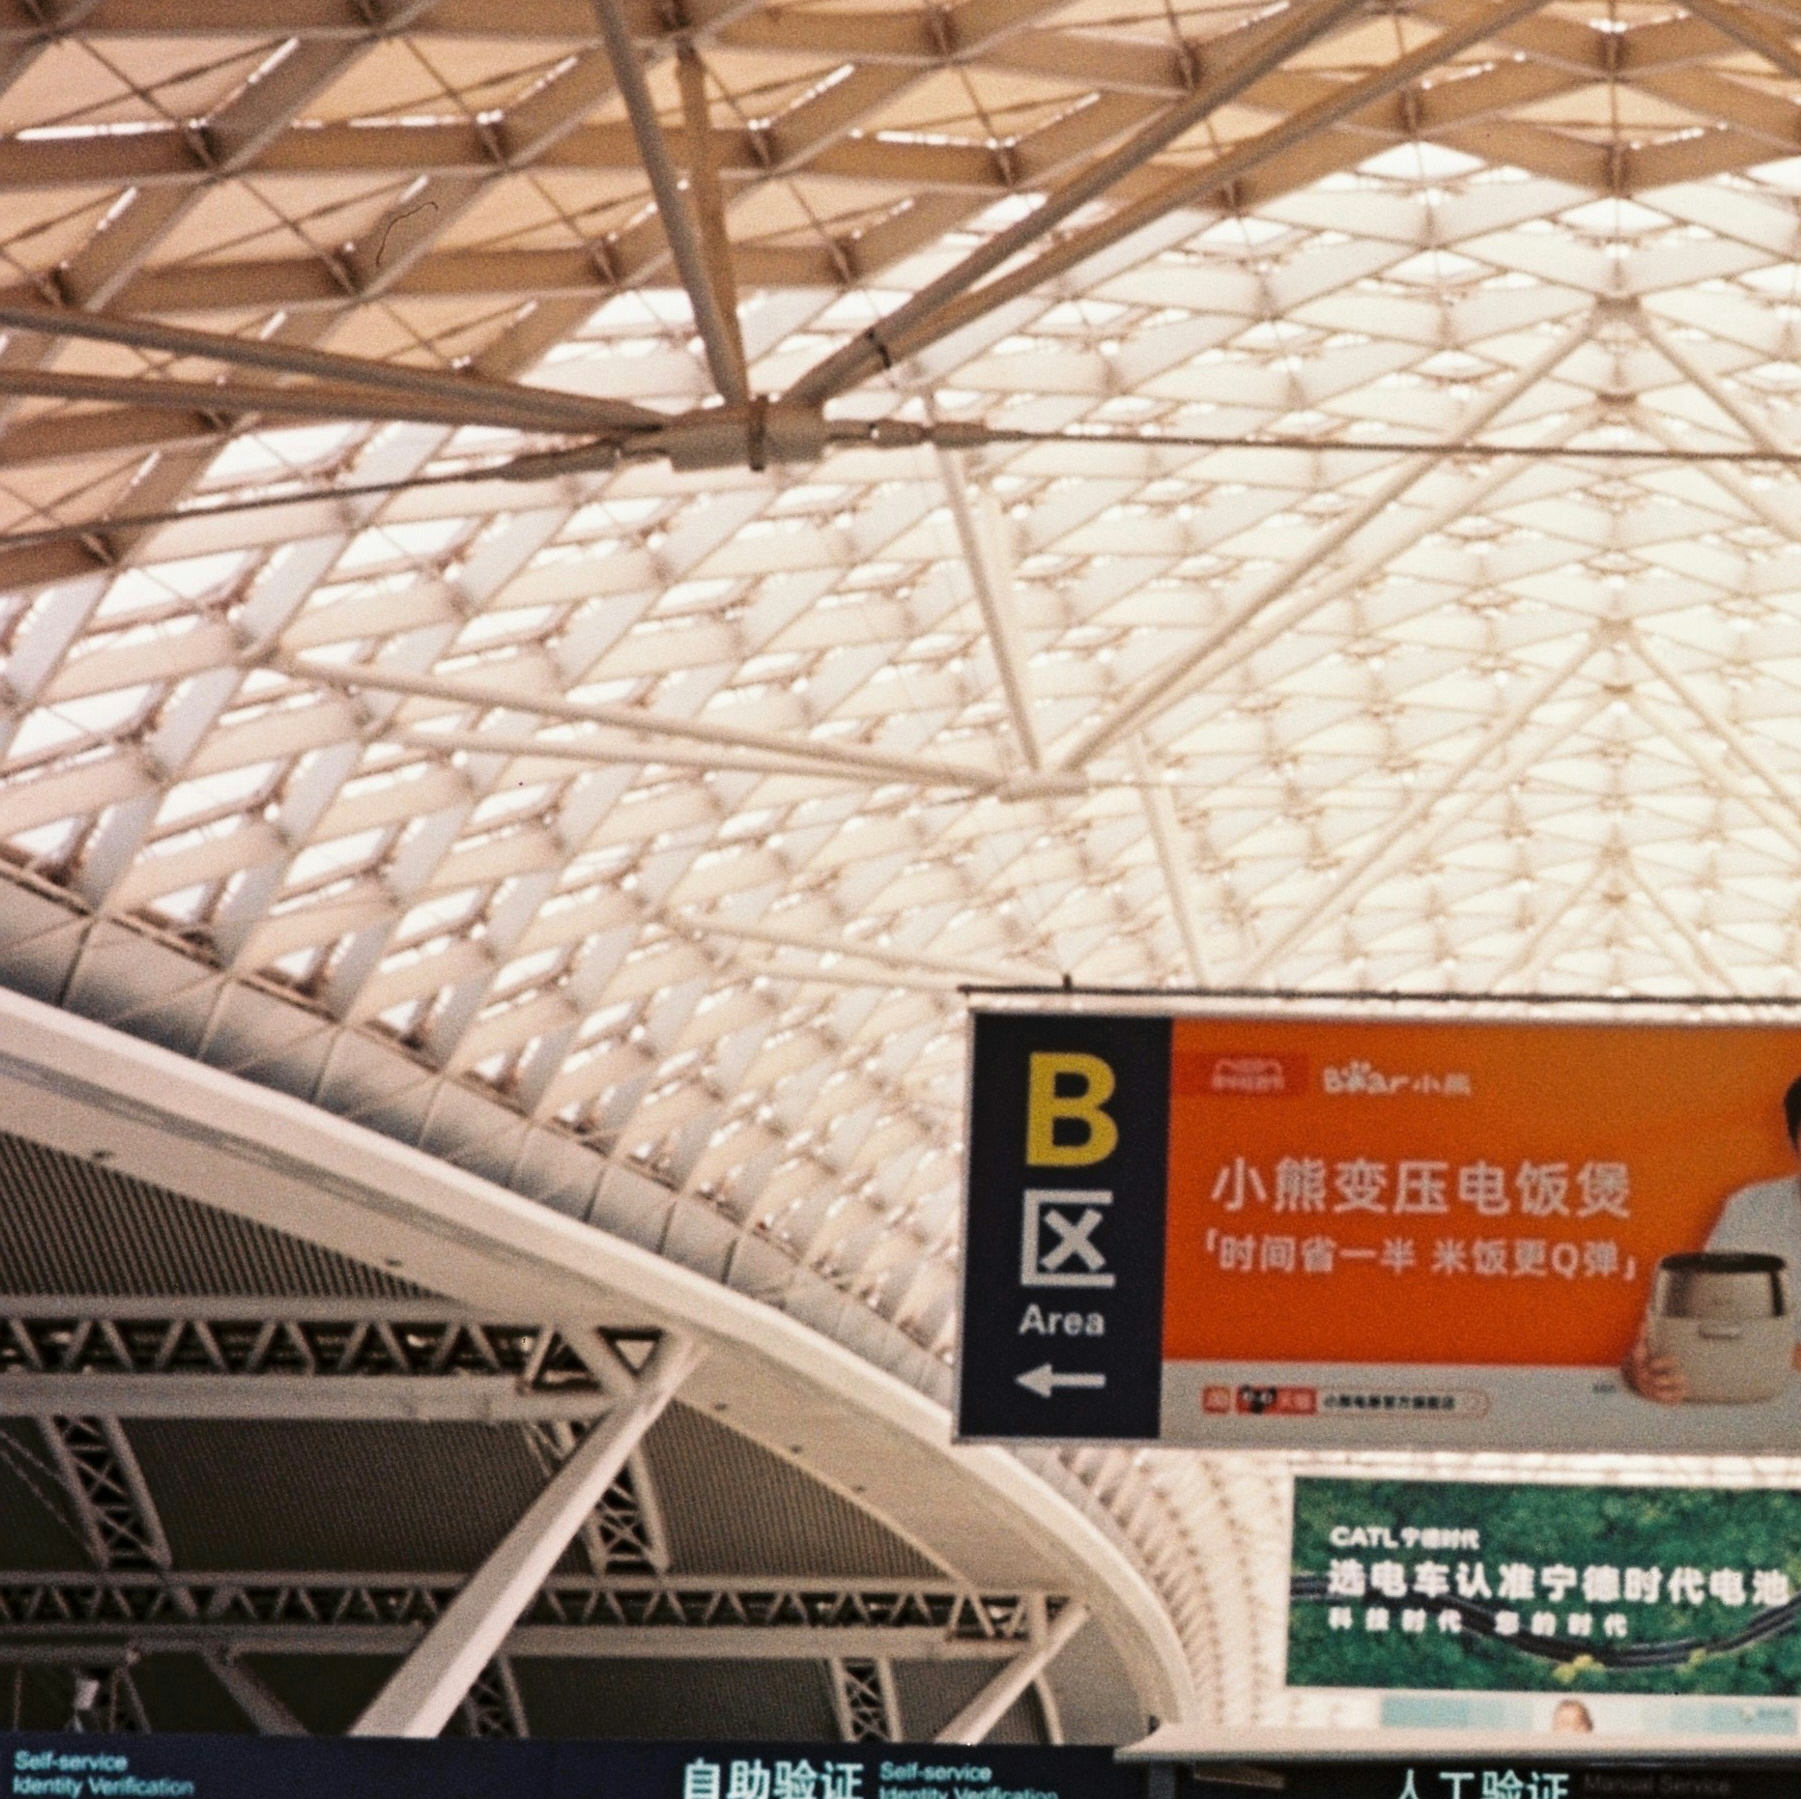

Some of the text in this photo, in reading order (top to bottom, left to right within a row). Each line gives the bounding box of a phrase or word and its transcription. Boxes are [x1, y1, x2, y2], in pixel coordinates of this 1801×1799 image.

[1026, 1052, 1119, 1167] B
[1211, 1156, 1630, 1218] 小熊变压电饭煲
[1021, 1188, 1115, 1288] 区
[1018, 1303, 1106, 1336] Area
[1330, 1526, 1480, 1551] CATL 宁德时代
[1327, 1559, 1790, 1607] 选电车认准宁德时代电池
[14, 1750, 128, 1772] Self-service
[879, 1761, 992, 1782] Self-service
[12, 1775, 195, 1799] Identity Verification
[1584, 1775, 1732, 1794] Manual Service
